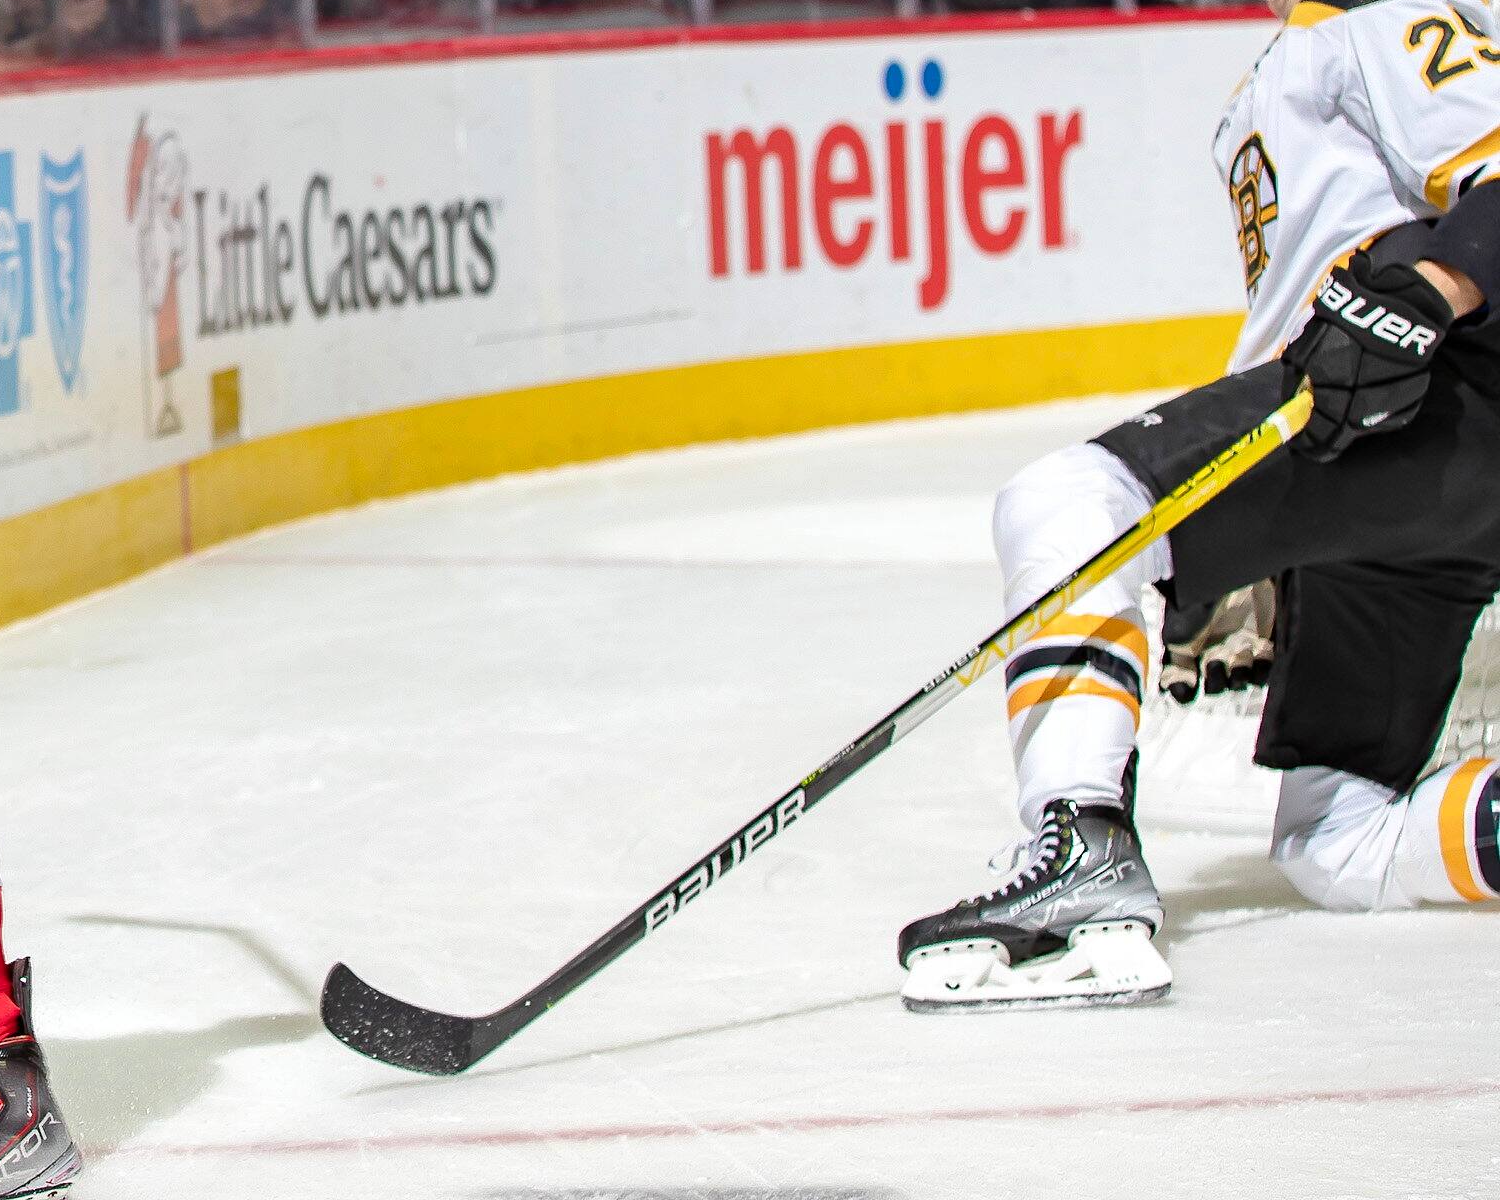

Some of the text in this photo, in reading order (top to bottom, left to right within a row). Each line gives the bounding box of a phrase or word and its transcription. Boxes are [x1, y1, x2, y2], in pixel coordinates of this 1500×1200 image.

[194, 173, 500, 338] Little Caesars
[706, 60, 1082, 310] meijer
[642, 786, 806, 942] BAUER
[1009, 880, 1063, 917] BAUER
